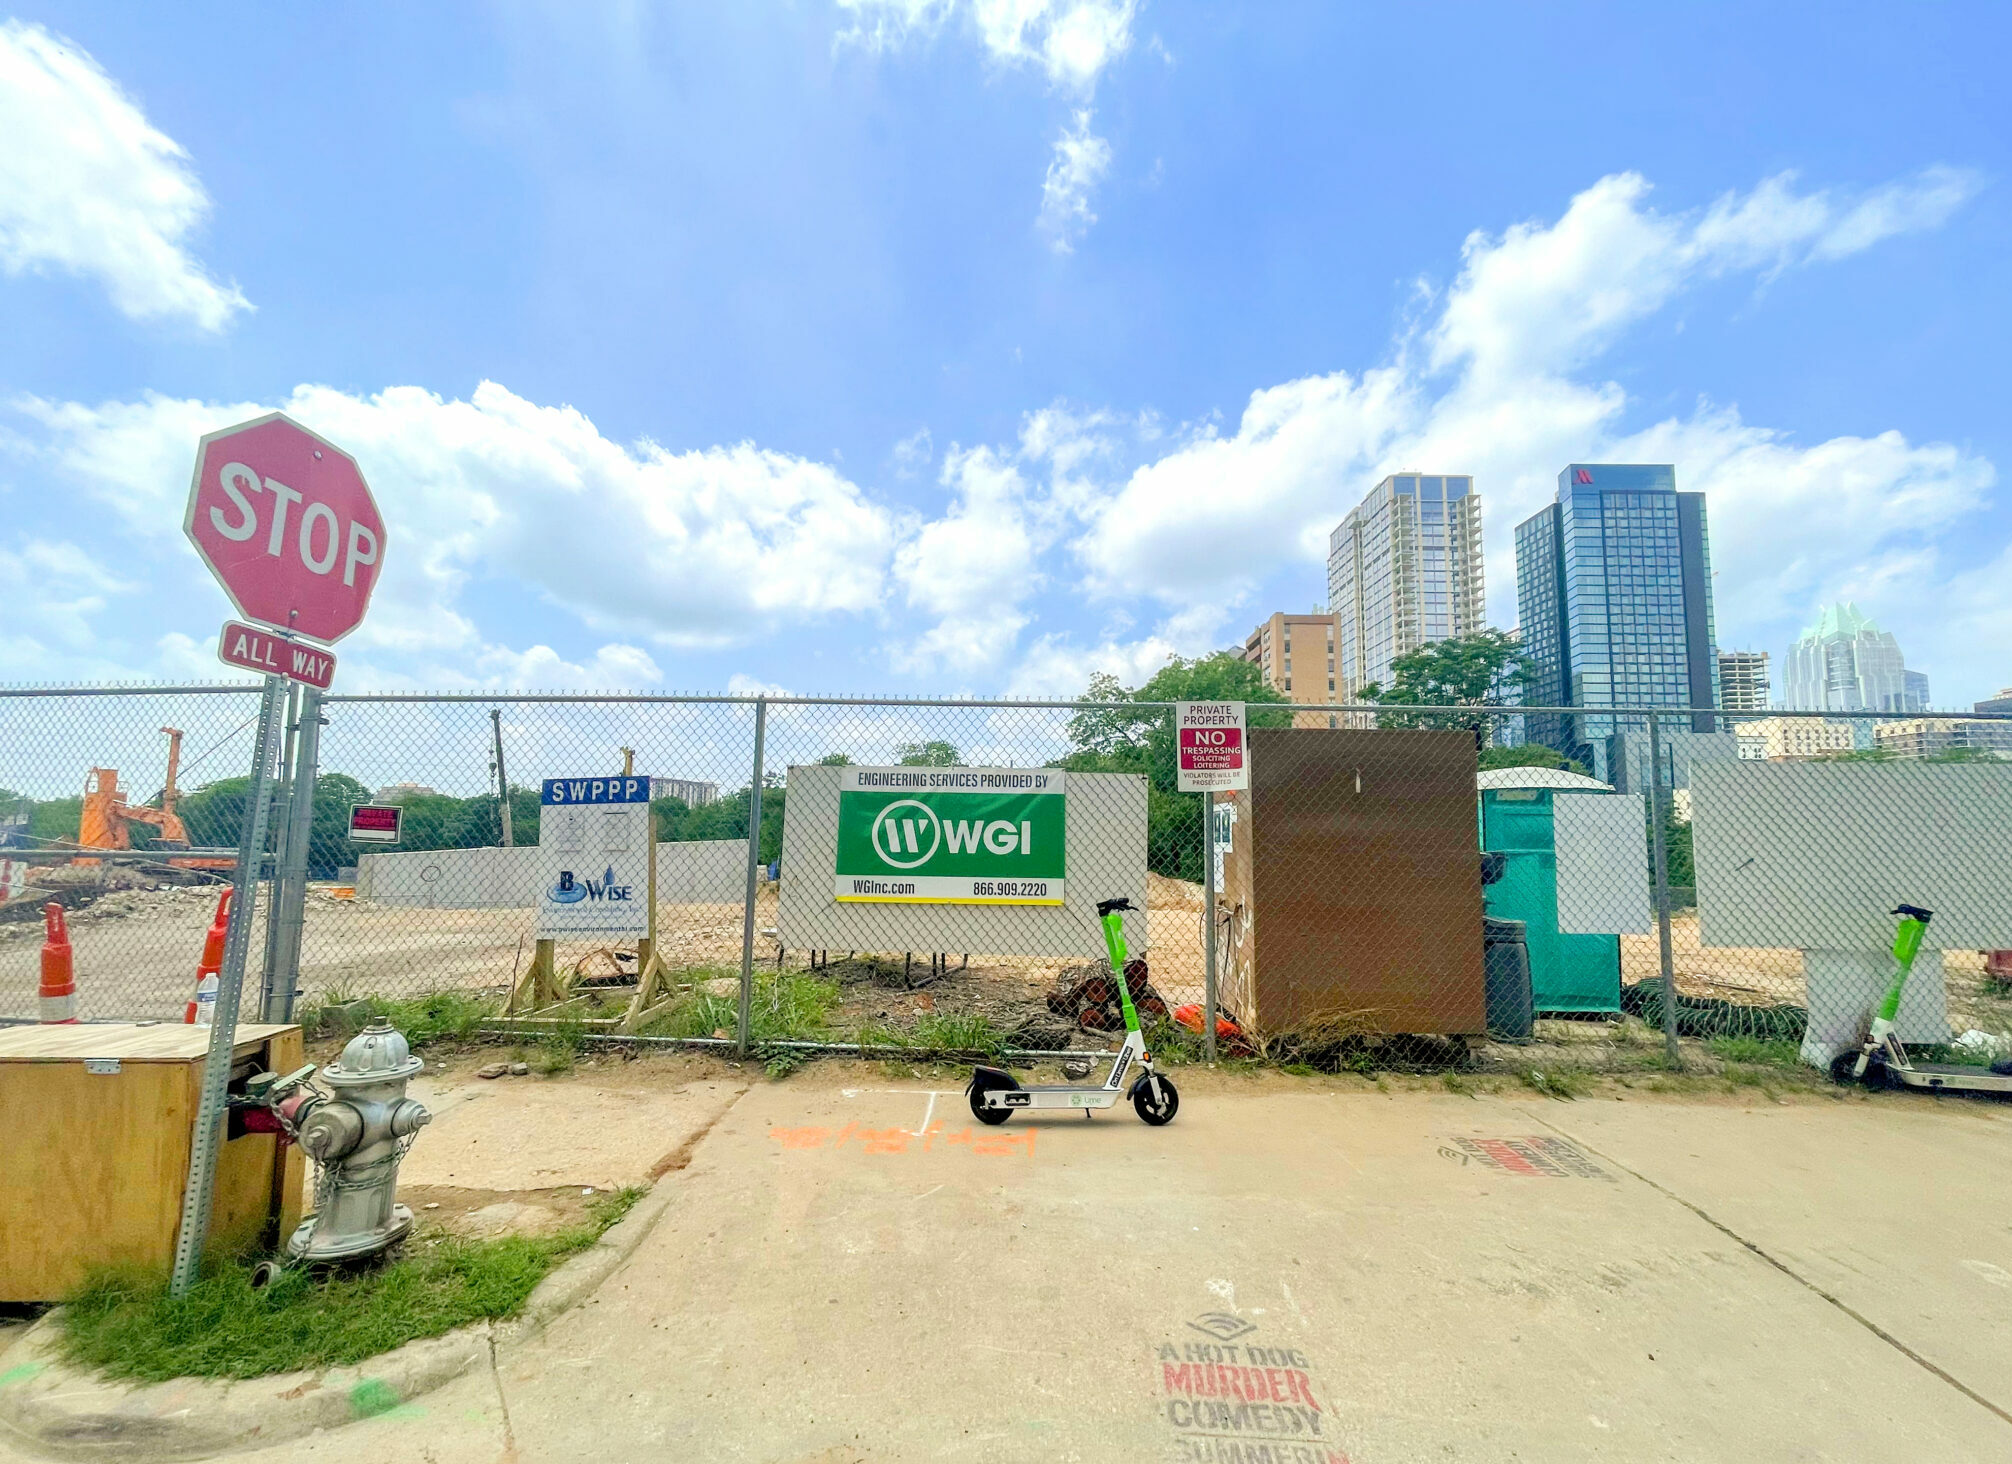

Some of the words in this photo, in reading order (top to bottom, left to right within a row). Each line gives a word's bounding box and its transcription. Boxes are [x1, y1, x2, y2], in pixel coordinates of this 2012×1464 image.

[209, 462, 378, 588] STOP
[232, 633, 278, 667] ALL
[292, 649, 329, 681] WAY
[1183, 715, 1239, 725] PROPERTY
[1190, 705, 1232, 715] PRIVATE
[1195, 731, 1226, 745] NO
[1182, 746, 1241, 755] TRESPASSING
[552, 780, 638, 802] SWPPP
[857, 772, 927, 787] ENGINEERING
[929, 773, 978, 788] SERVICES
[980, 774, 1033, 788] PROVIDED
[1035, 775, 1049, 788] BY
[943, 820, 1031, 855] WGI
[853, 879, 915, 895] WGInc.com
[973, 882, 1047, 897] 866.909.2220
[1159, 1342, 1180, 1361] A
[1184, 1343, 1239, 1364] HOT
[1247, 1346, 1310, 1369] DOG
[1163, 1362, 1323, 1413] MURDER
[1167, 1400, 1322, 1435] COMEDY
